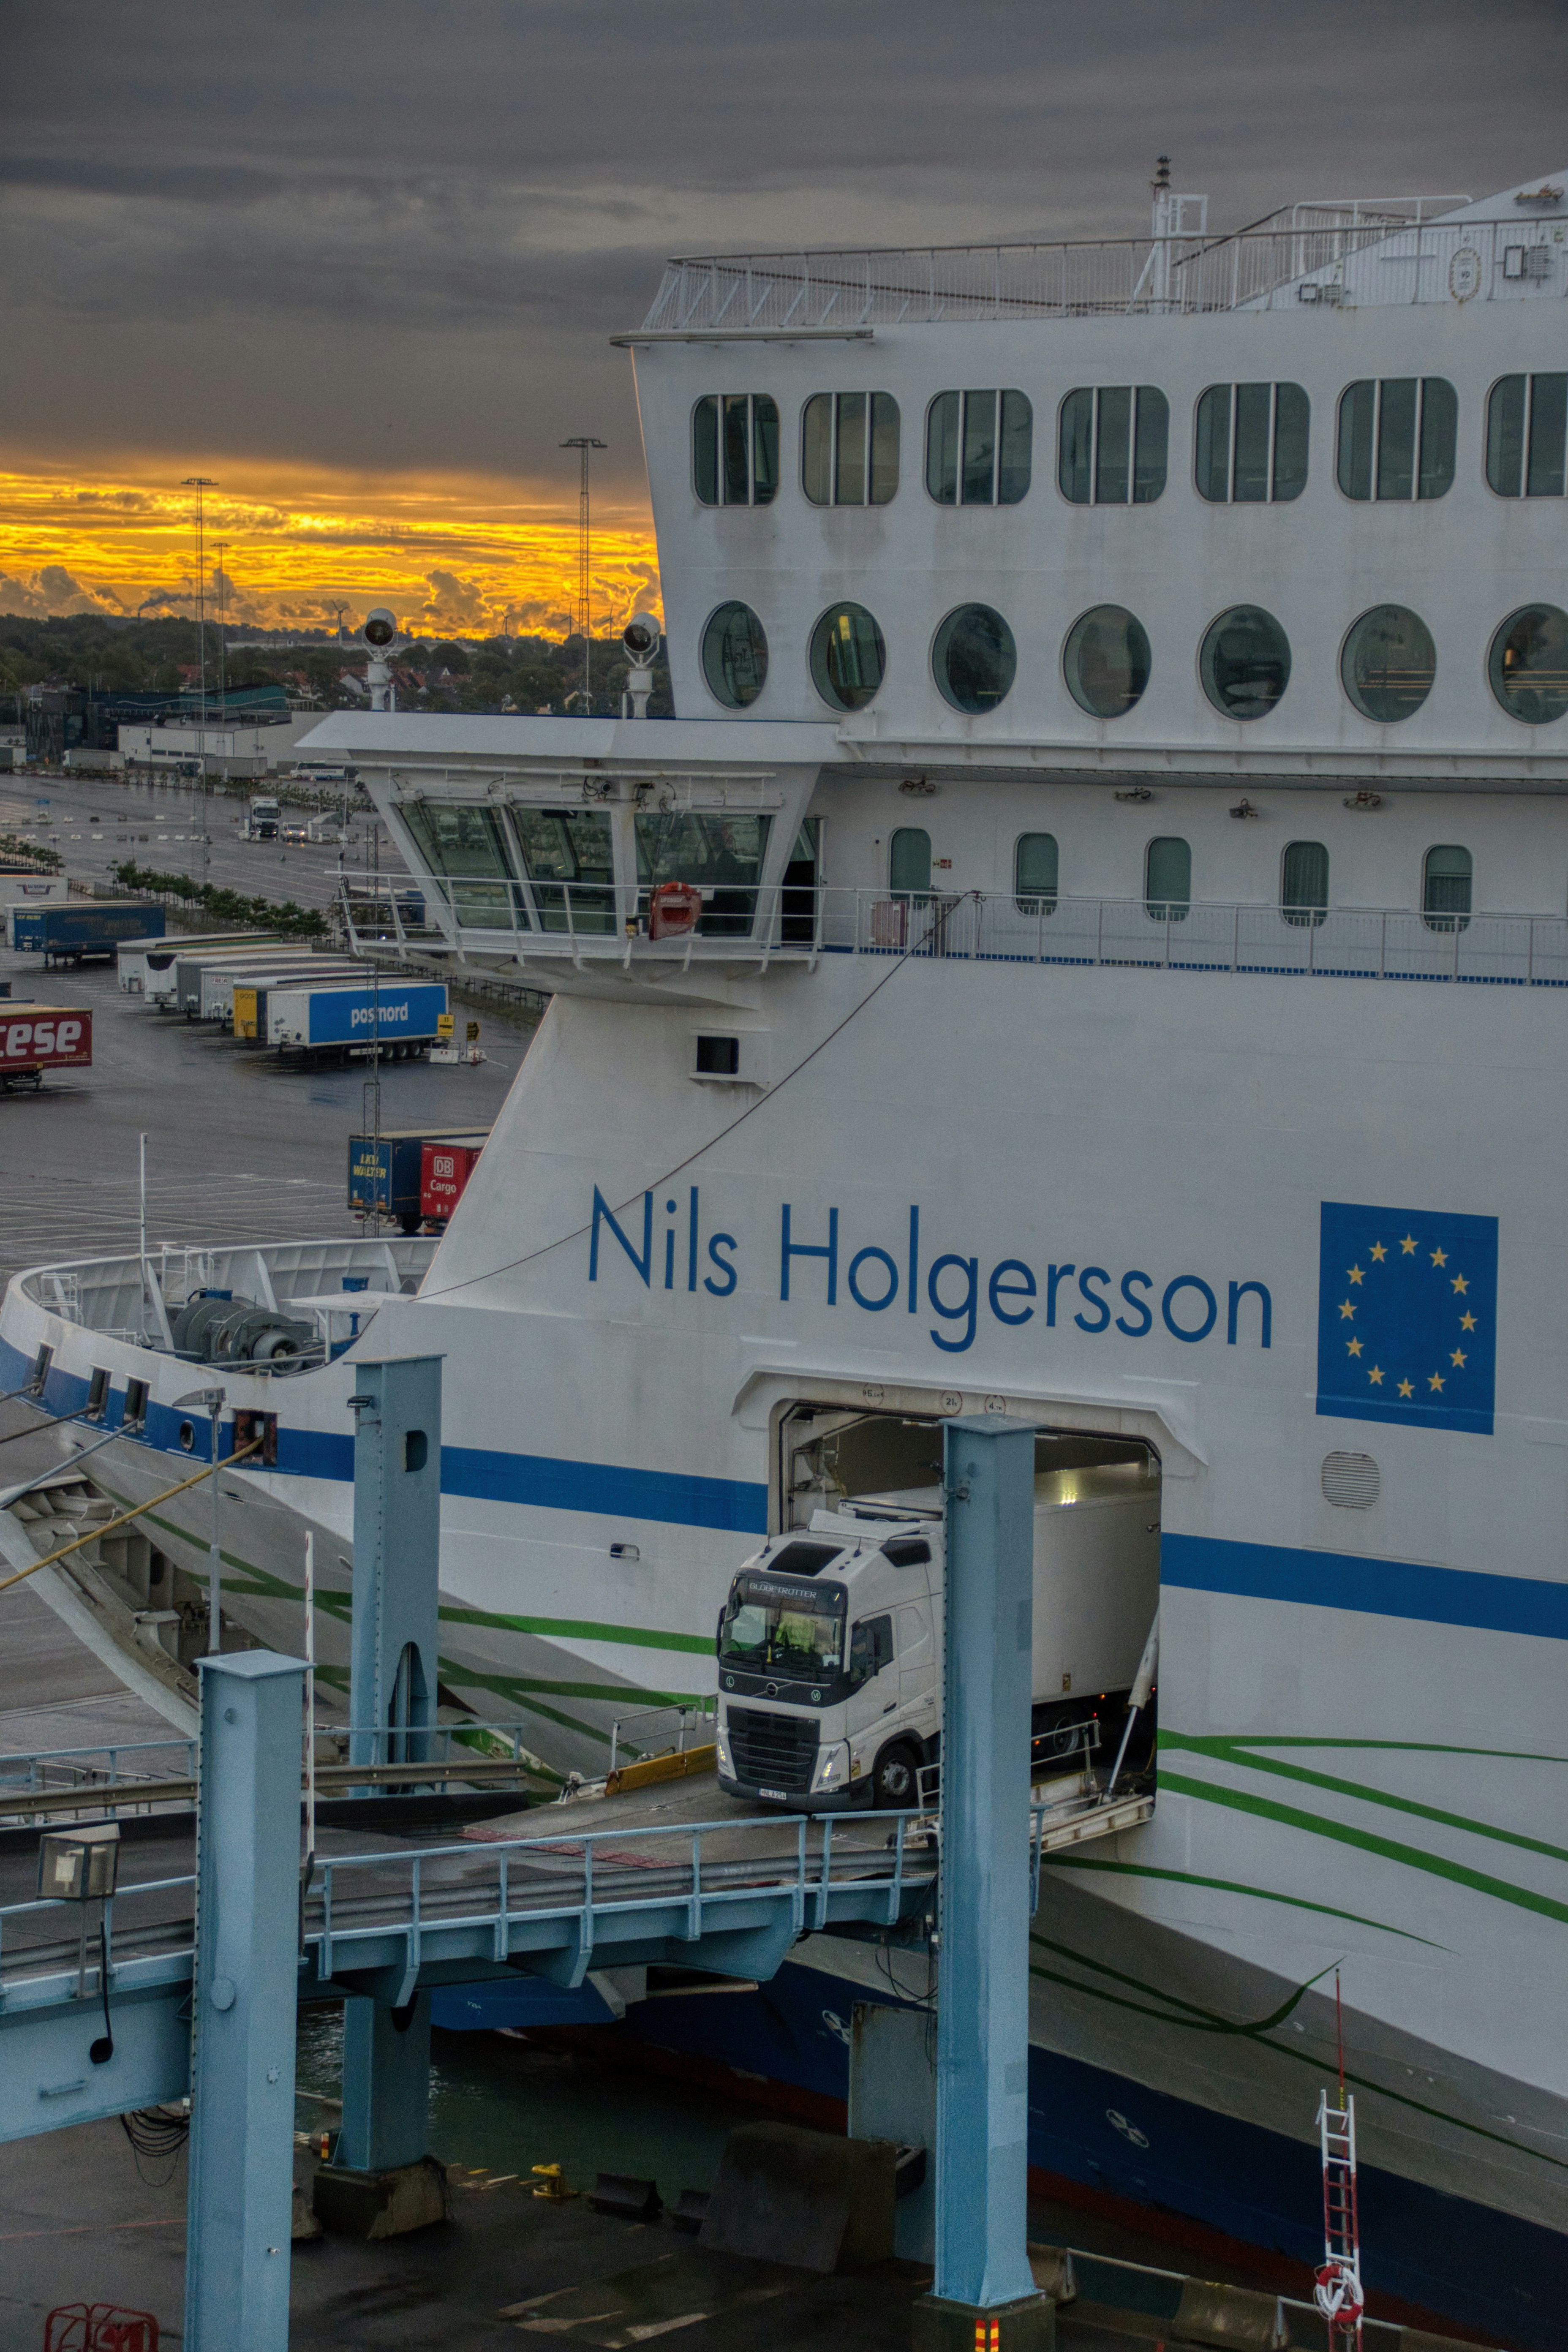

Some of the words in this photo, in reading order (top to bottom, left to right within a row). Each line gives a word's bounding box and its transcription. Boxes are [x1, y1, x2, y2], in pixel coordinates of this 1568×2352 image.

[351, 1002, 408, 1028] posnord
[436, 1159, 452, 1174] DB
[430, 1179, 457, 1195] Cargo
[589, 1184, 738, 1297] Nils
[780, 1204, 1272, 1353] Holgersson
[750, 1582, 817, 1598] GLOBETROTTER
